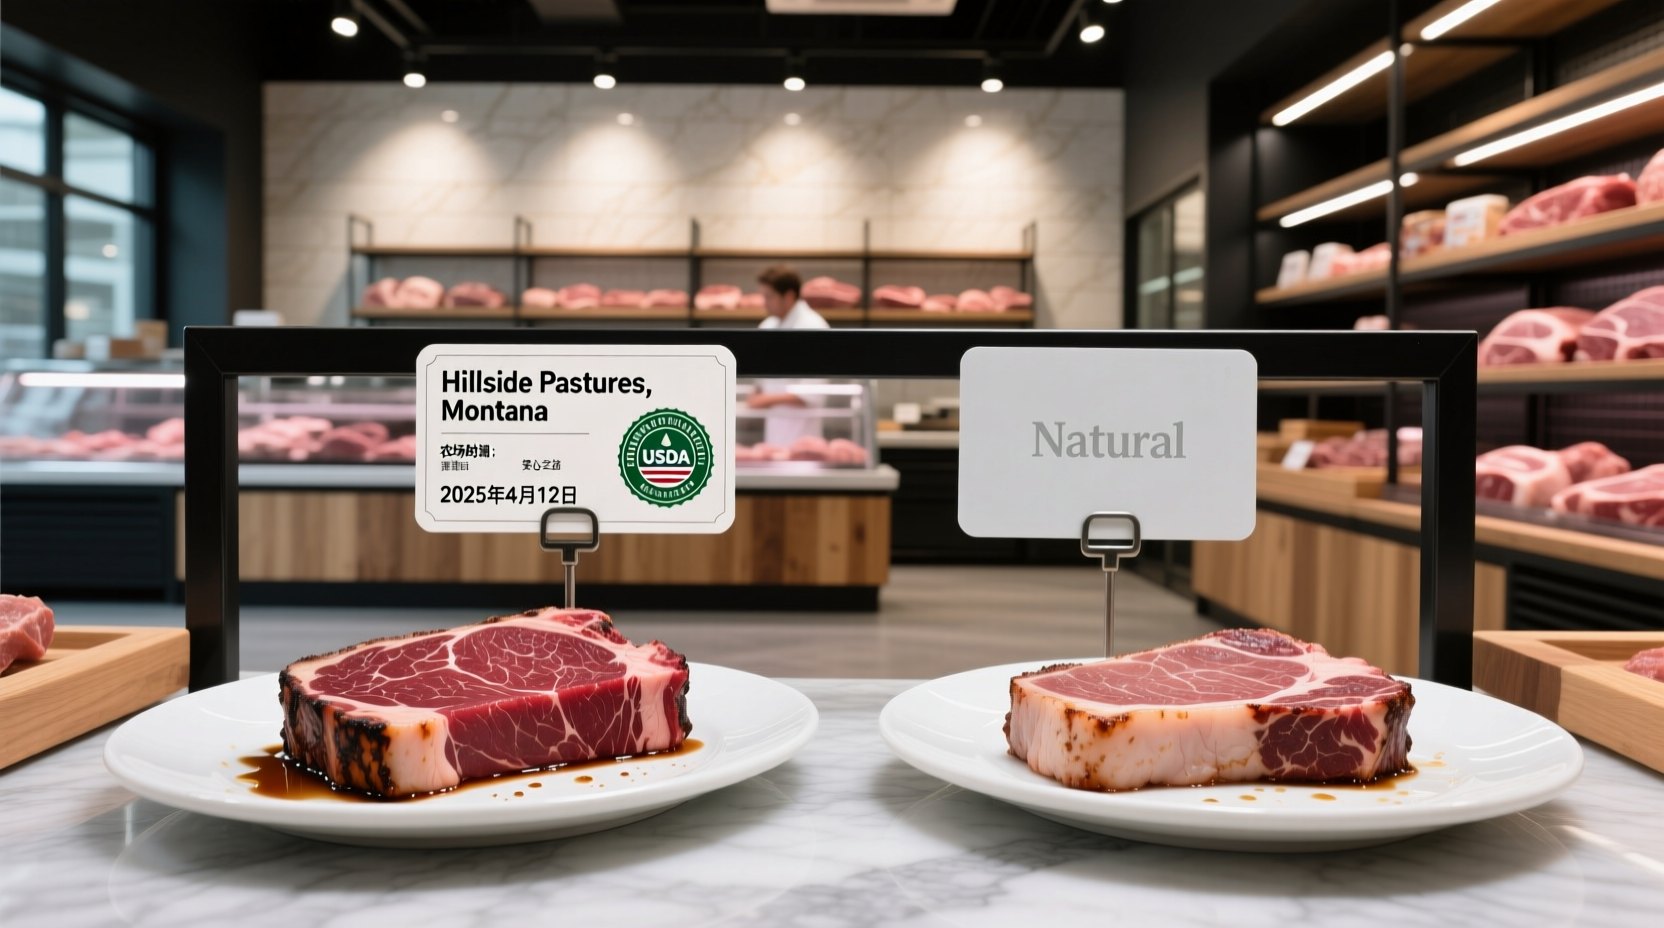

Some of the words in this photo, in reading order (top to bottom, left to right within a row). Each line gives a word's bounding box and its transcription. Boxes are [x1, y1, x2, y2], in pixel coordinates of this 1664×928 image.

[441, 369, 533, 394] Hillside
[540, 370, 652, 398] Pastures,
[441, 399, 548, 422] Montana
[1032, 420, 1186, 459] Natural
[642, 449, 691, 465] USDA
[440, 484, 577, 505] 2025年4月12日
